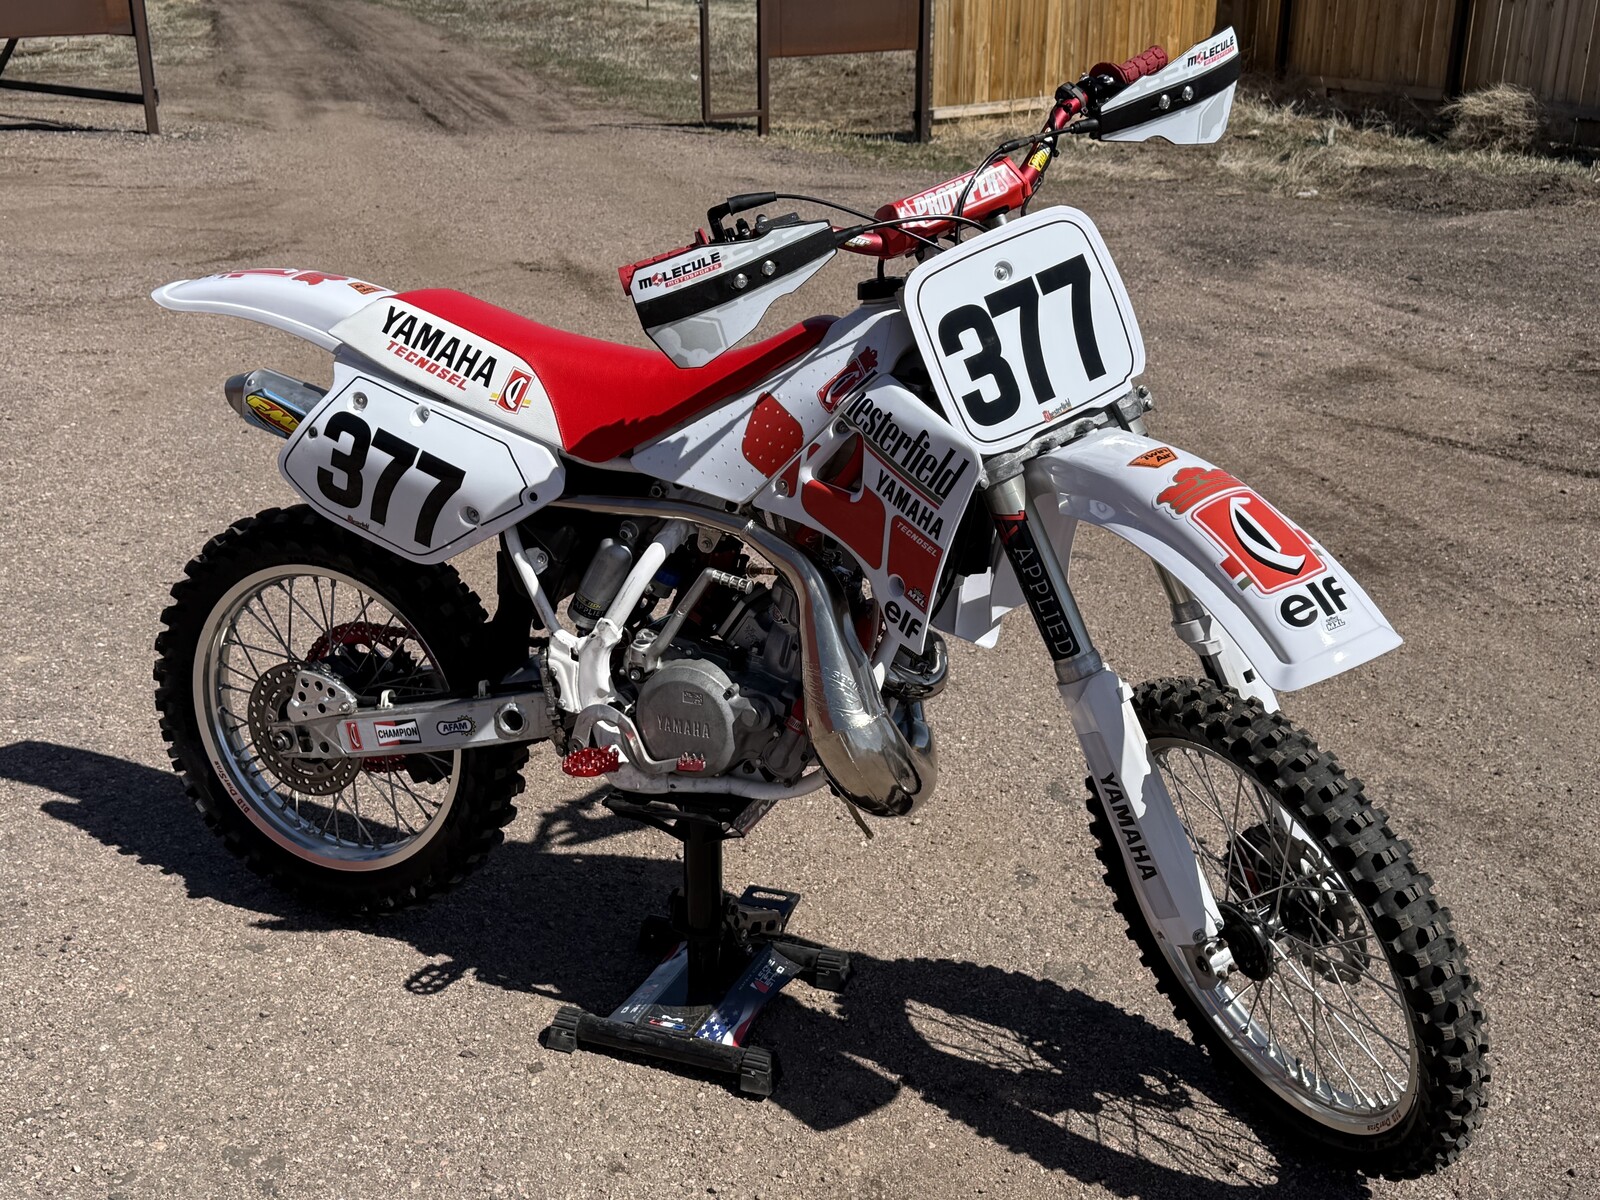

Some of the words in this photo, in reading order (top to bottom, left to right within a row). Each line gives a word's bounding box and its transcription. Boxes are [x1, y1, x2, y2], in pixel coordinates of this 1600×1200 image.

[382, 305, 497, 388] YAMAHA
[386, 340, 468, 391] TECNOSEL
[938, 253, 1107, 426] 377
[316, 411, 466, 549] 377
[876, 469, 944, 541] YAMAHA
[897, 522, 938, 557] TECNOSEL
[884, 600, 922, 640] elf
[1014, 548, 1074, 655] APPLIED
[1280, 576, 1348, 628] elf
[378, 727, 418, 739] CHAMPION
[443, 721, 468, 732] AFAM
[657, 714, 710, 739] YAMAHA
[1100, 771, 1158, 881] YAMAHA
